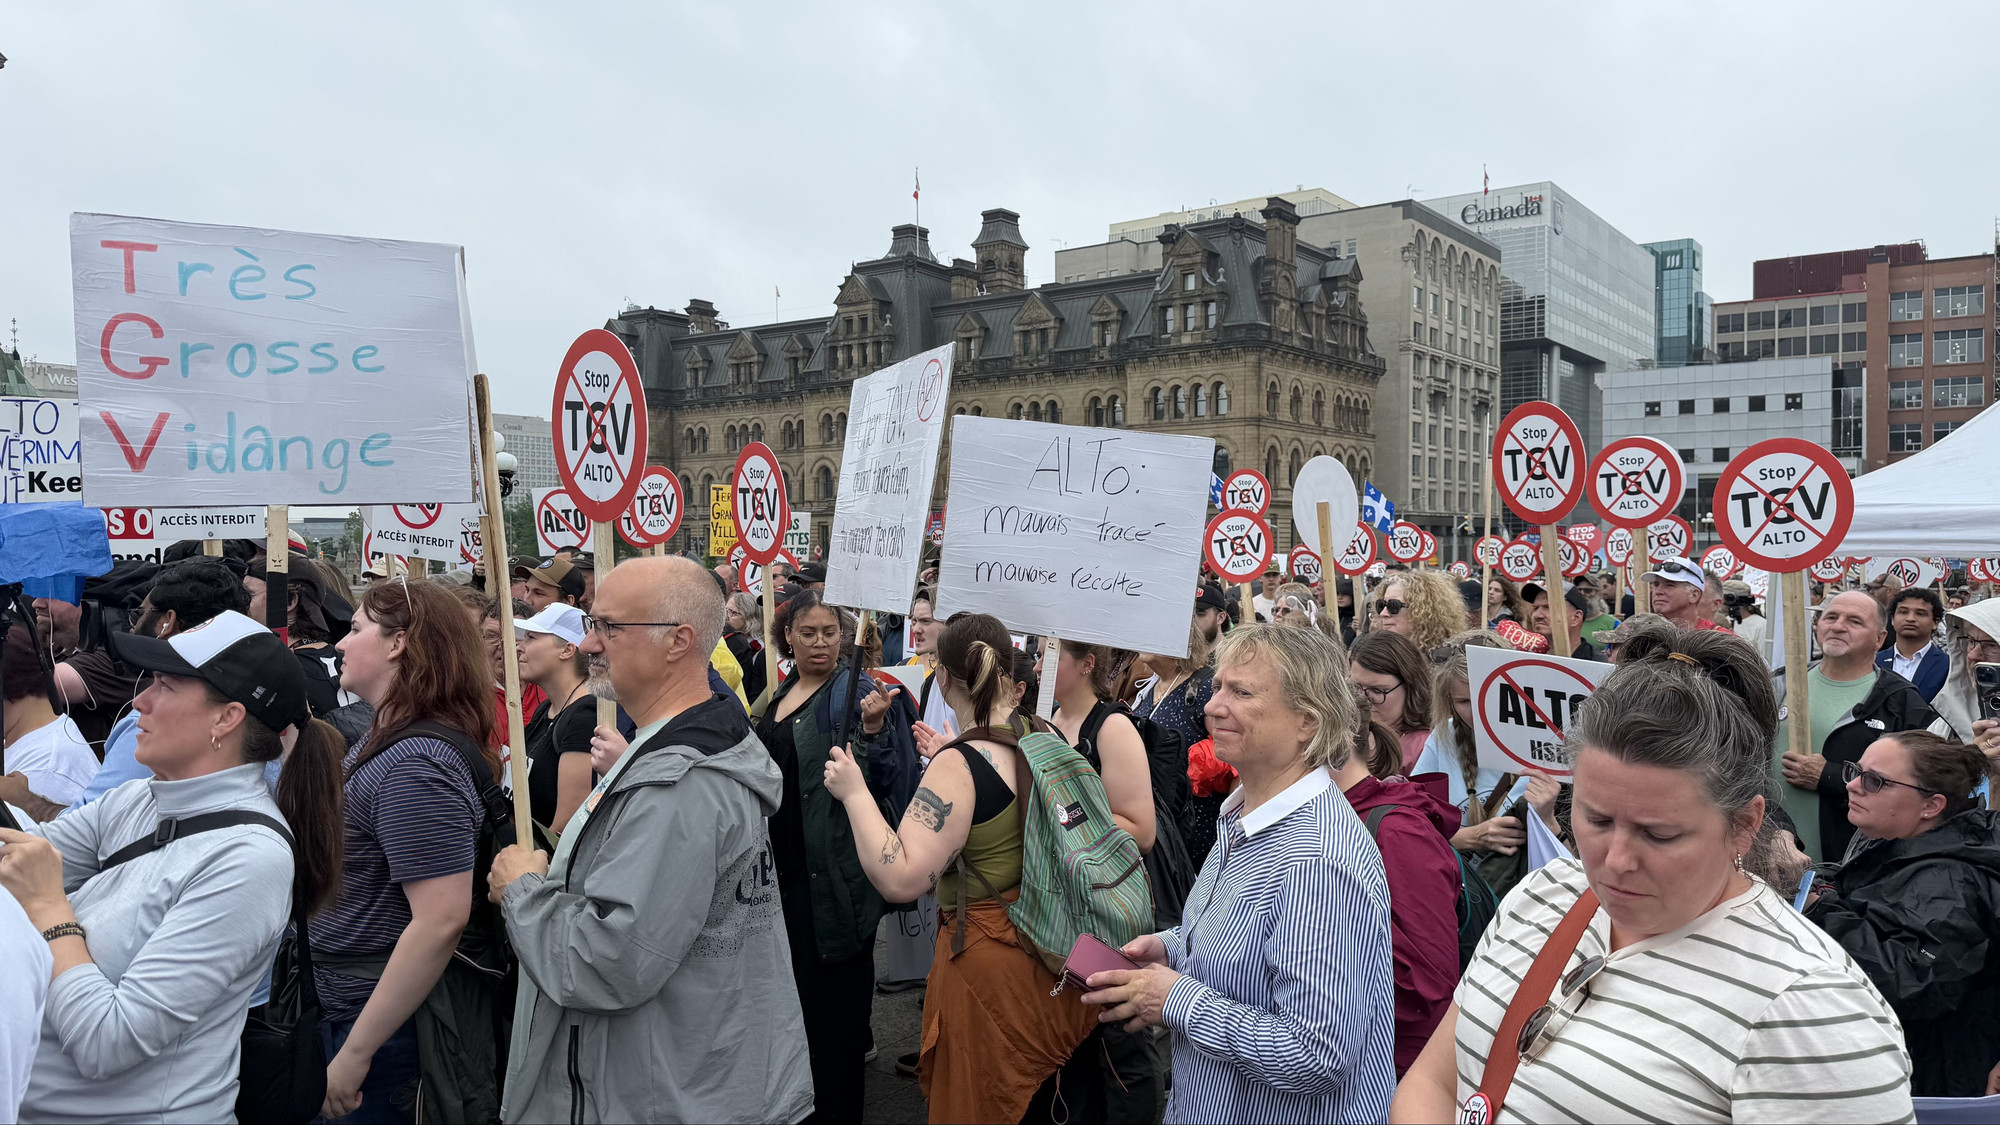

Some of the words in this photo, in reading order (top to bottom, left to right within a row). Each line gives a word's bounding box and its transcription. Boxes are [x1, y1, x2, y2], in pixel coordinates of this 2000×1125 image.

[1461, 197, 1542, 225] Canada
[100, 239, 317, 300] Très
[100, 312, 386, 380] Grosse
[584, 369, 610, 394] Stop
[564, 400, 633, 456] TGV
[1522, 427, 1548, 442] Stop
[99, 411, 396, 495] Vidange
[1504, 444, 1571, 482] TGV
[1619, 456, 1645, 468] Stop
[583, 463, 613, 484] ALTO
[749, 467, 765, 483] Stop
[1758, 465, 1797, 482] Stop
[647, 481, 663, 491] Stop
[1238, 479, 1253, 487] Stop
[1598, 468, 1667, 498] TGV
[1227, 487, 1264, 505] TGV
[1525, 486, 1555, 500] ALTO
[636, 493, 676, 517] TGV
[738, 487, 778, 522] TGV
[1619, 499, 1649, 511] ALTO
[1730, 481, 1831, 528] TGV
[160, 513, 198, 526] ACCÈS
[200, 514, 257, 525] INTERDIT
[543, 507, 587, 533] ALTO
[647, 519, 666, 528] ALTO
[1653, 523, 1670, 531] Stop
[751, 527, 769, 540] ALTO
[1226, 524, 1246, 533] Stop
[1569, 526, 1596, 535] STOP
[1569, 532, 1595, 541] ALTO
[376, 530, 407, 542] ACCÈS
[409, 534, 455, 549] INTERDIT
[1213, 532, 1262, 559] TGV
[1389, 535, 1419, 549] TGV
[1608, 538, 1633, 553] TGV
[1647, 529, 1683, 550] TGV
[1762, 529, 1807, 547] ALTO
[1657, 547, 1676, 557] ALTO
[1231, 558, 1253, 569] ALTO
[1343, 557, 1361, 566] ALTO
[1503, 553, 1535, 569] TGV
[1704, 554, 1733, 570] TGV
[1294, 564, 1320, 575] TGV
[1889, 563, 1918, 583] ALTO
